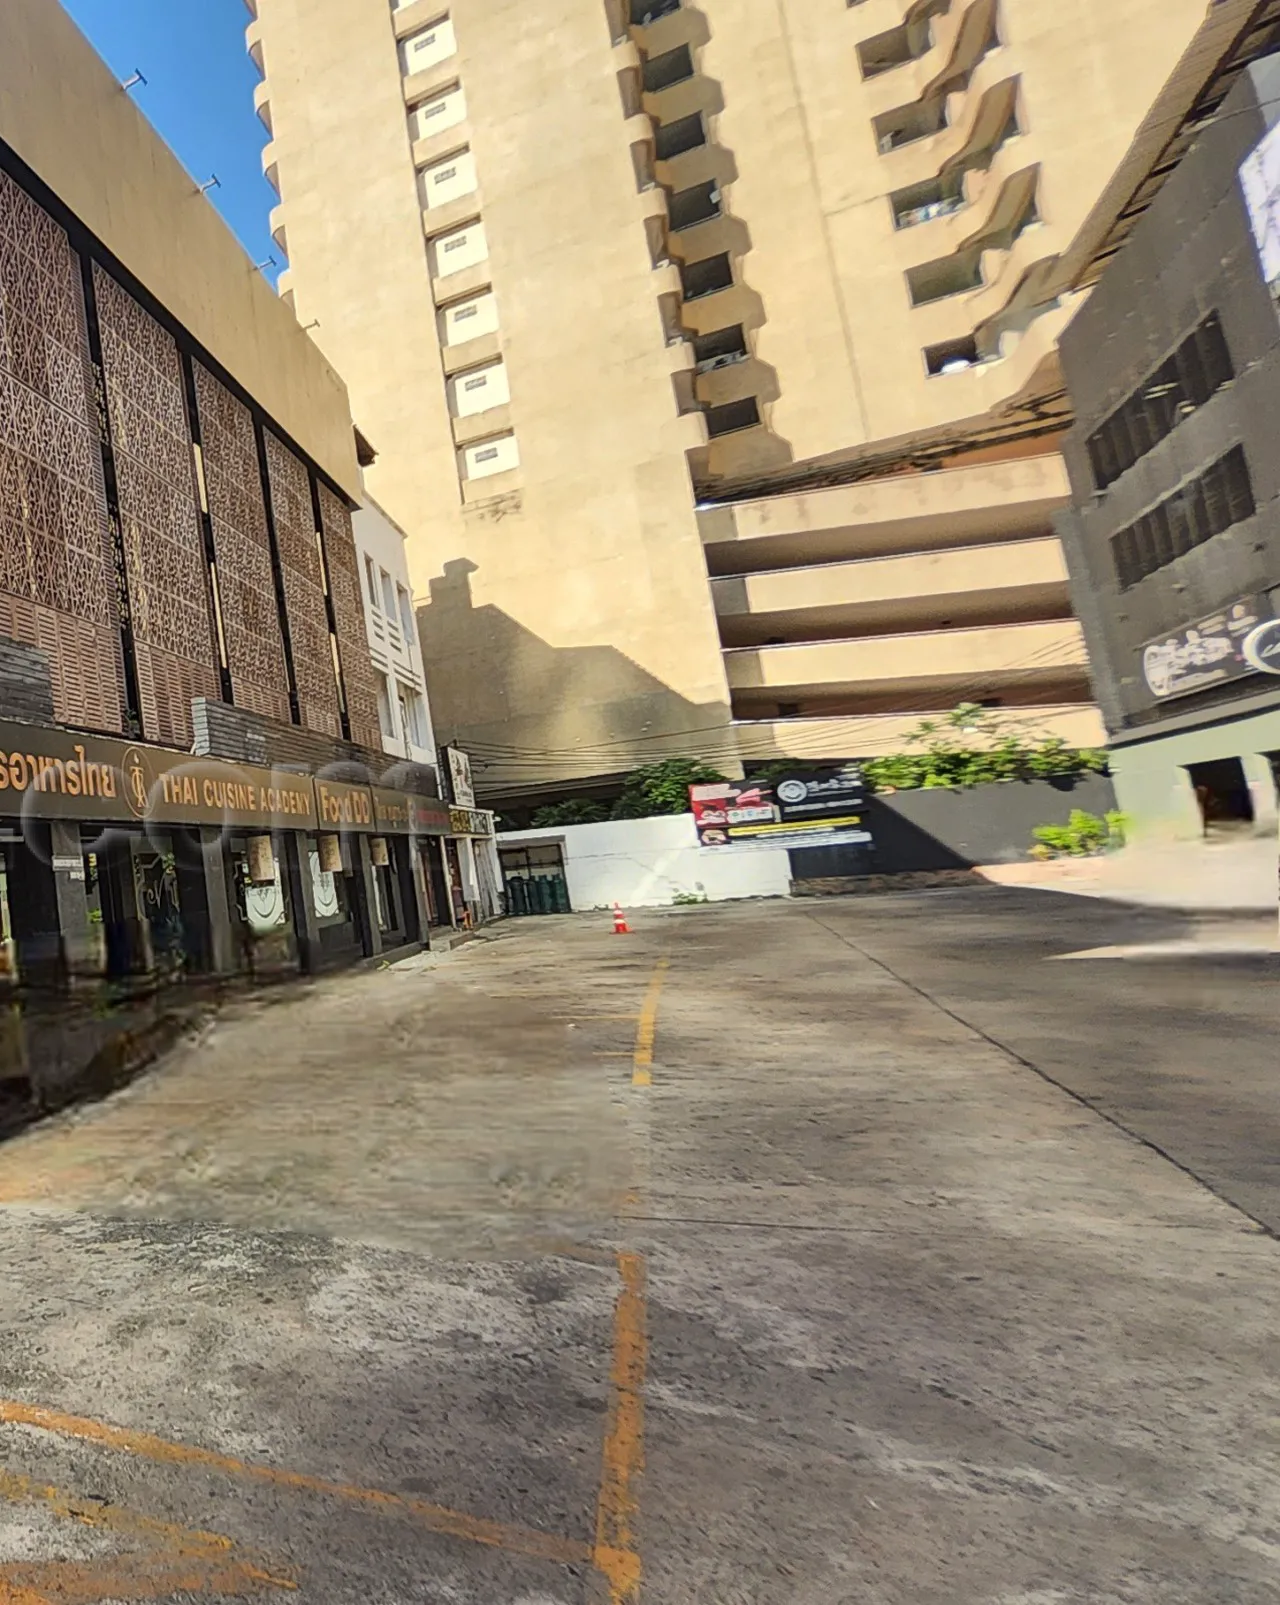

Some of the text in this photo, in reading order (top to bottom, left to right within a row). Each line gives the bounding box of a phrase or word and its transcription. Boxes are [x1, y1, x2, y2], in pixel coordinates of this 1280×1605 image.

[158, 773, 200, 806] THAI
[203, 778, 258, 812] CUISINE
[260, 786, 312, 817] ACADEMY
